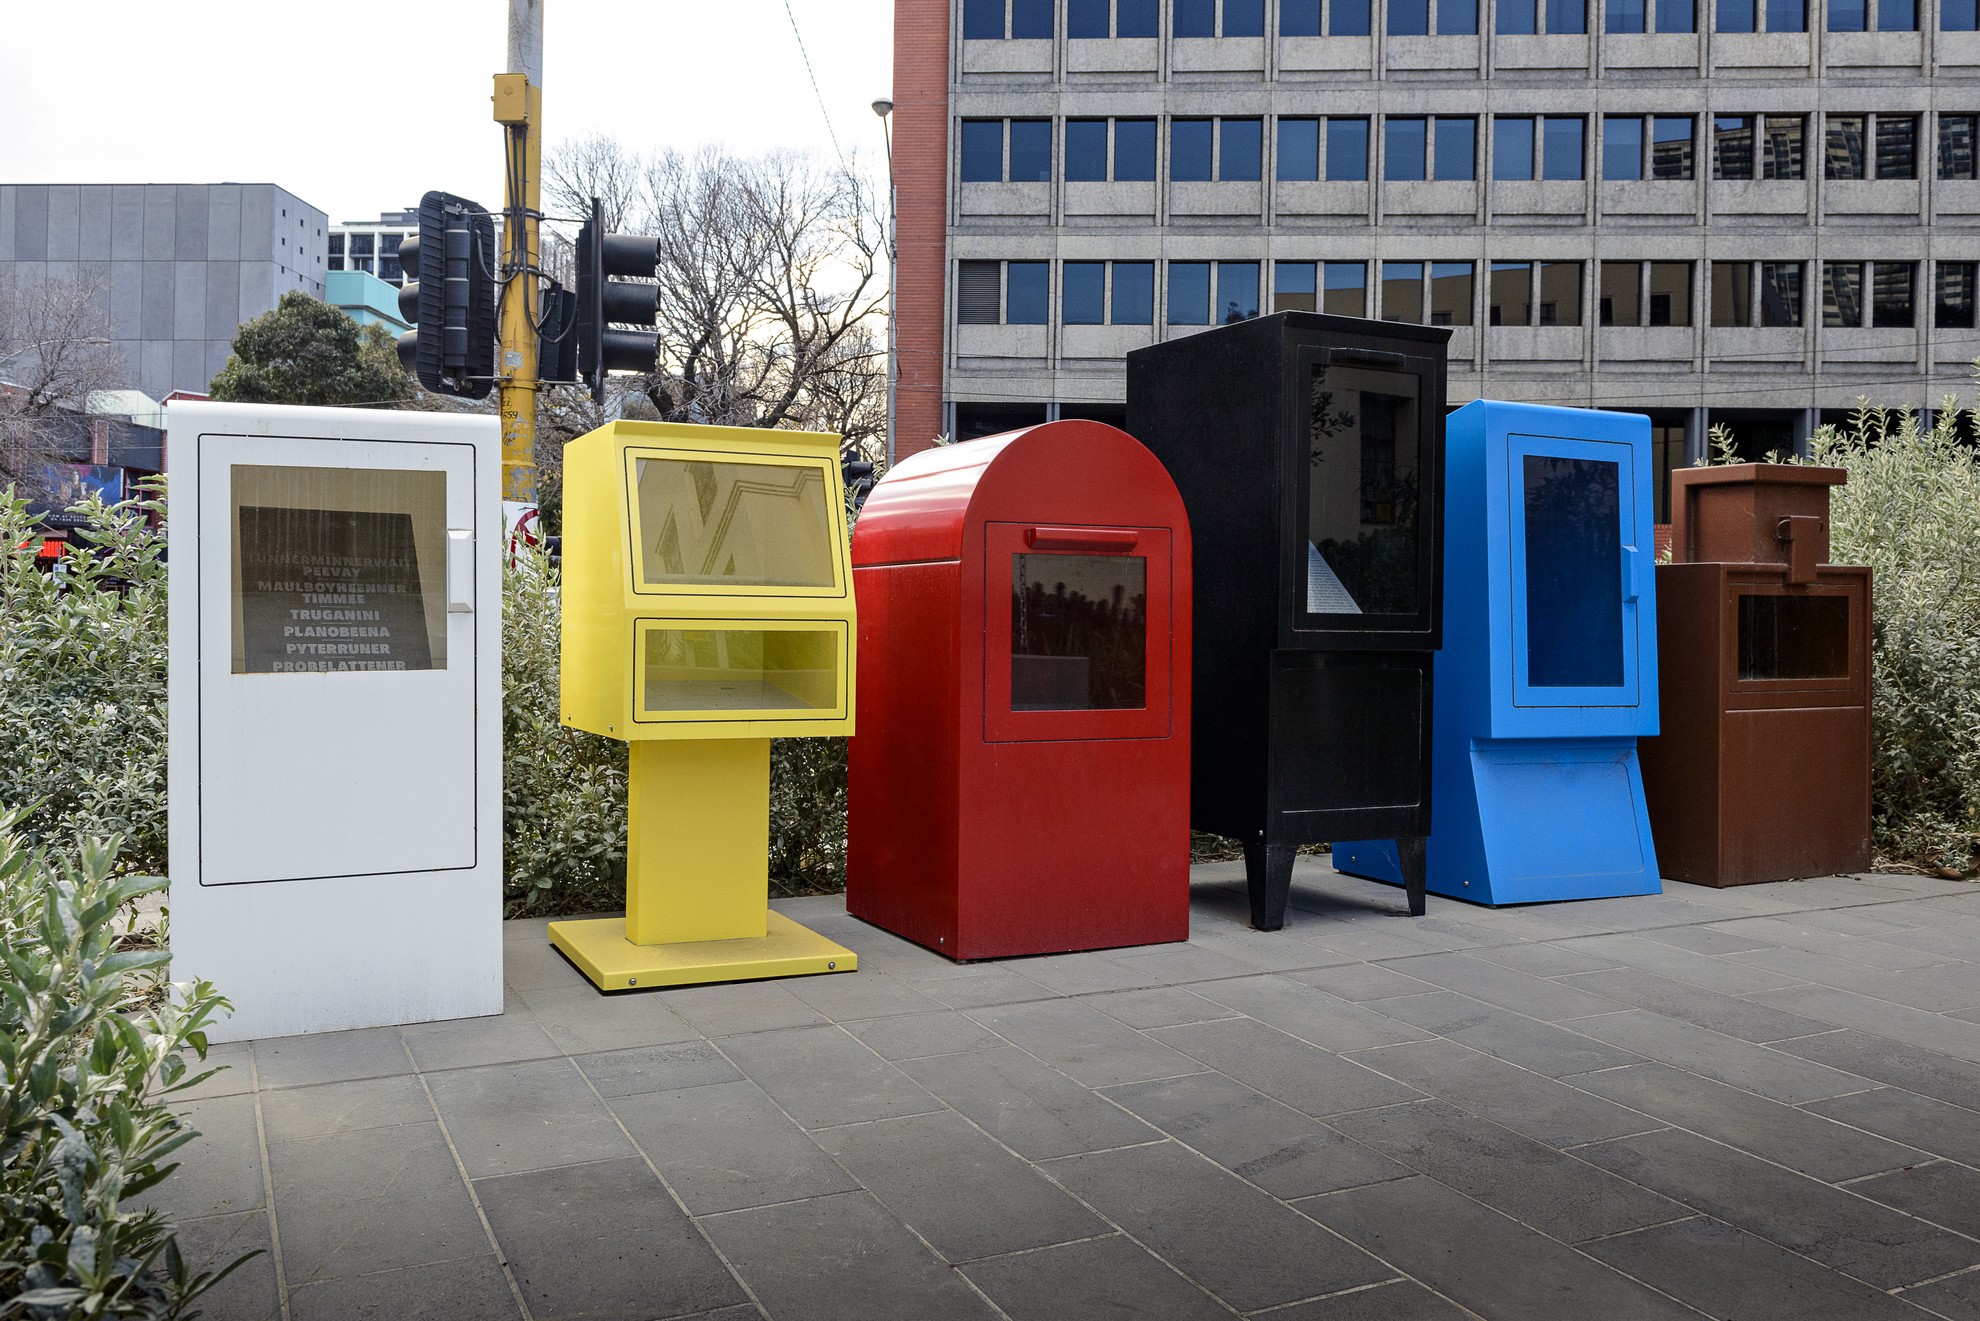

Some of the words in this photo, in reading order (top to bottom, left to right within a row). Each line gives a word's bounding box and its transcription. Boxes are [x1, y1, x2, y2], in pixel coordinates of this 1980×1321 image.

[302, 566, 362, 578] PEEVAY
[257, 580, 408, 594] MAULBOYHEENNER
[302, 593, 366, 604] TIMMEE
[289, 609, 380, 621] TRUGANINI
[283, 626, 391, 638] PLANOBEENA
[286, 643, 391, 655] PYTERRUNER
[272, 660, 407, 672] PROBELATTENER
